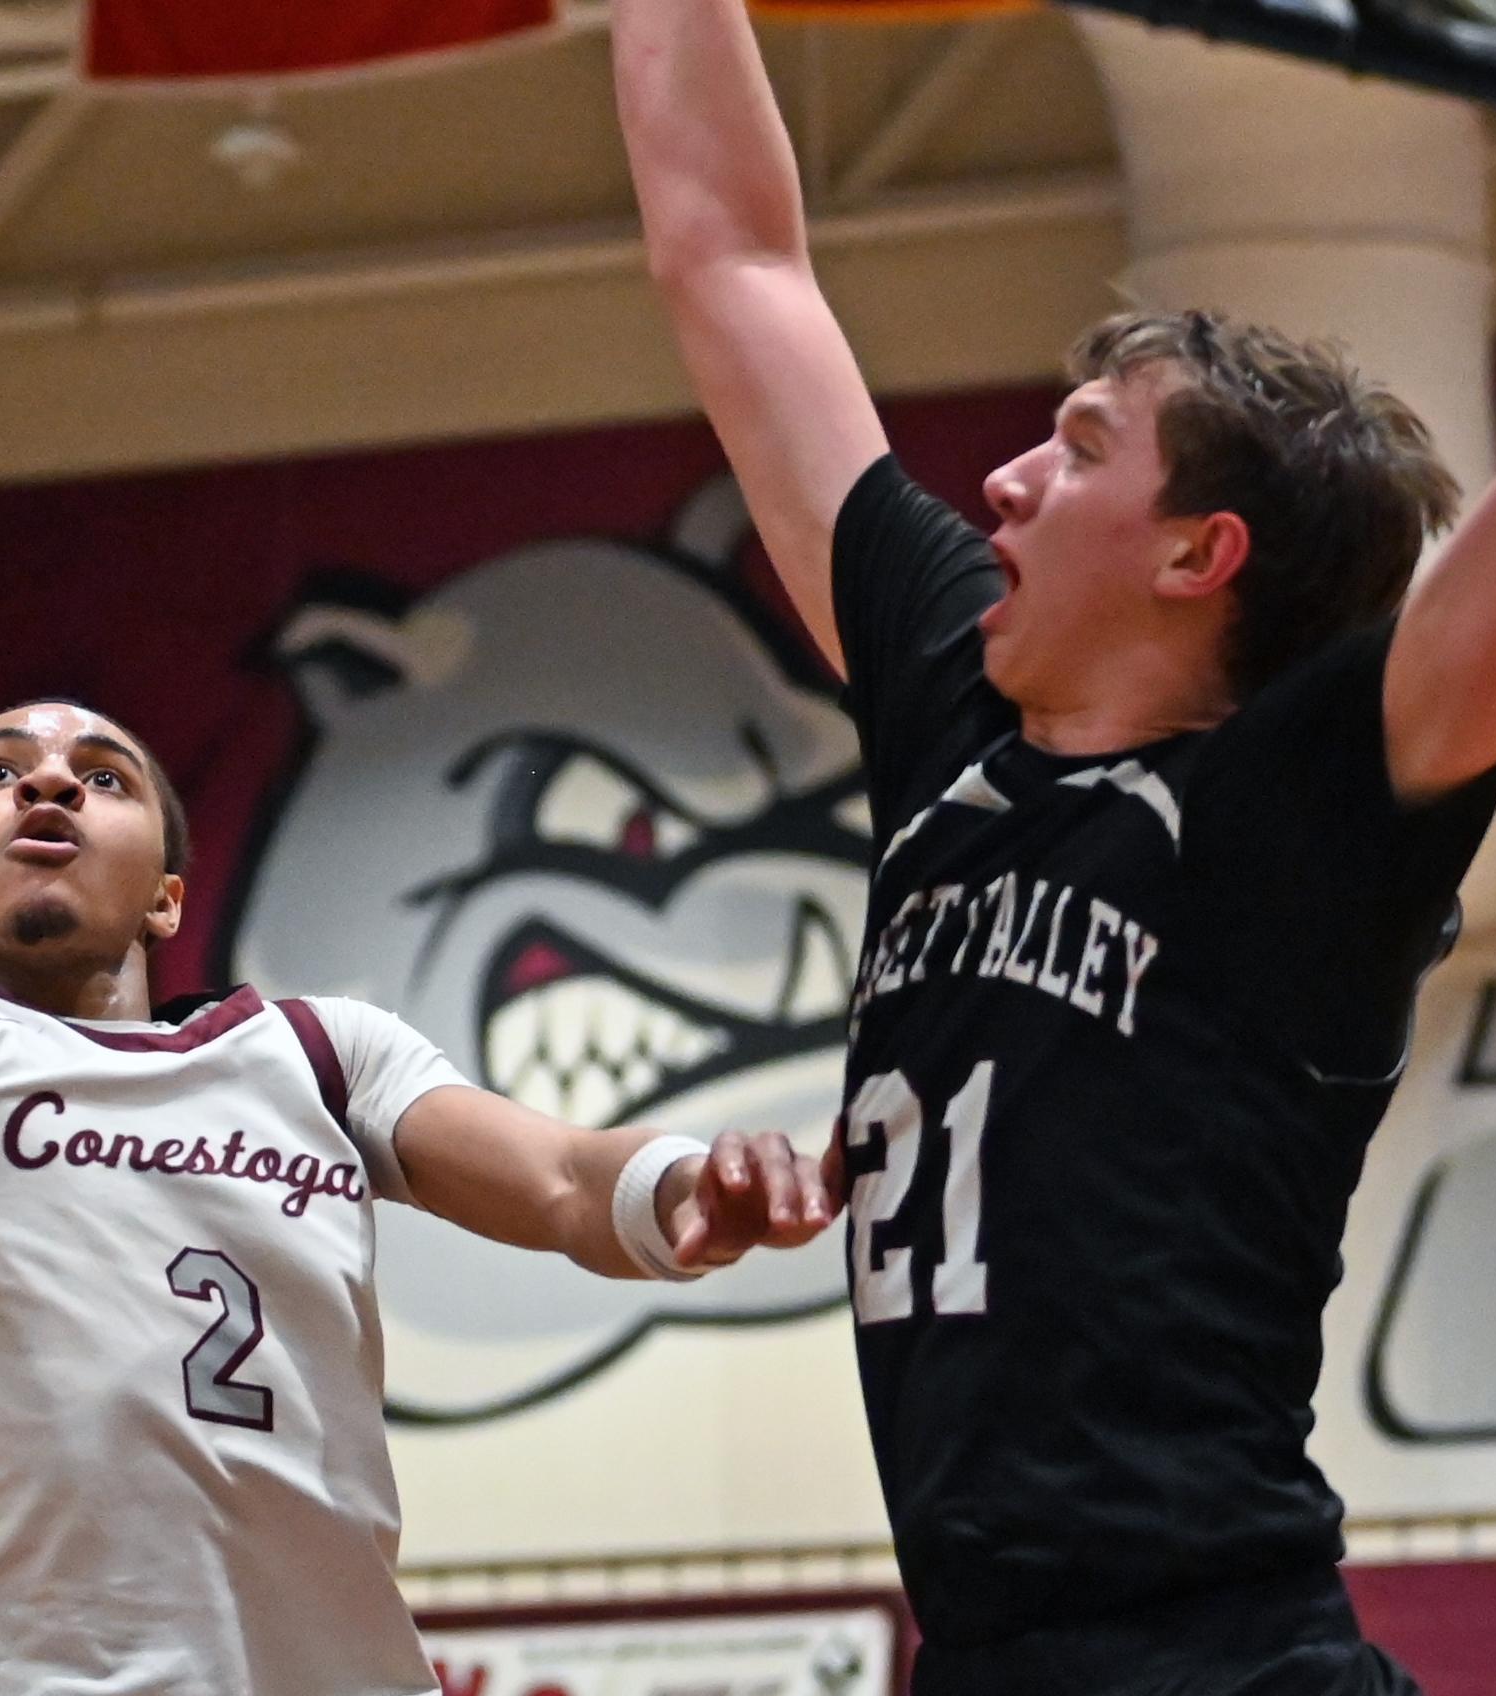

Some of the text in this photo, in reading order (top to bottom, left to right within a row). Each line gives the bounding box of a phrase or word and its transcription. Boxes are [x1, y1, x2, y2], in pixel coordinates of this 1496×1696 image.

[2, 1090, 364, 1218] Conestoga
[846, 1060, 995, 1324] 21
[166, 1247, 274, 1432] 2
